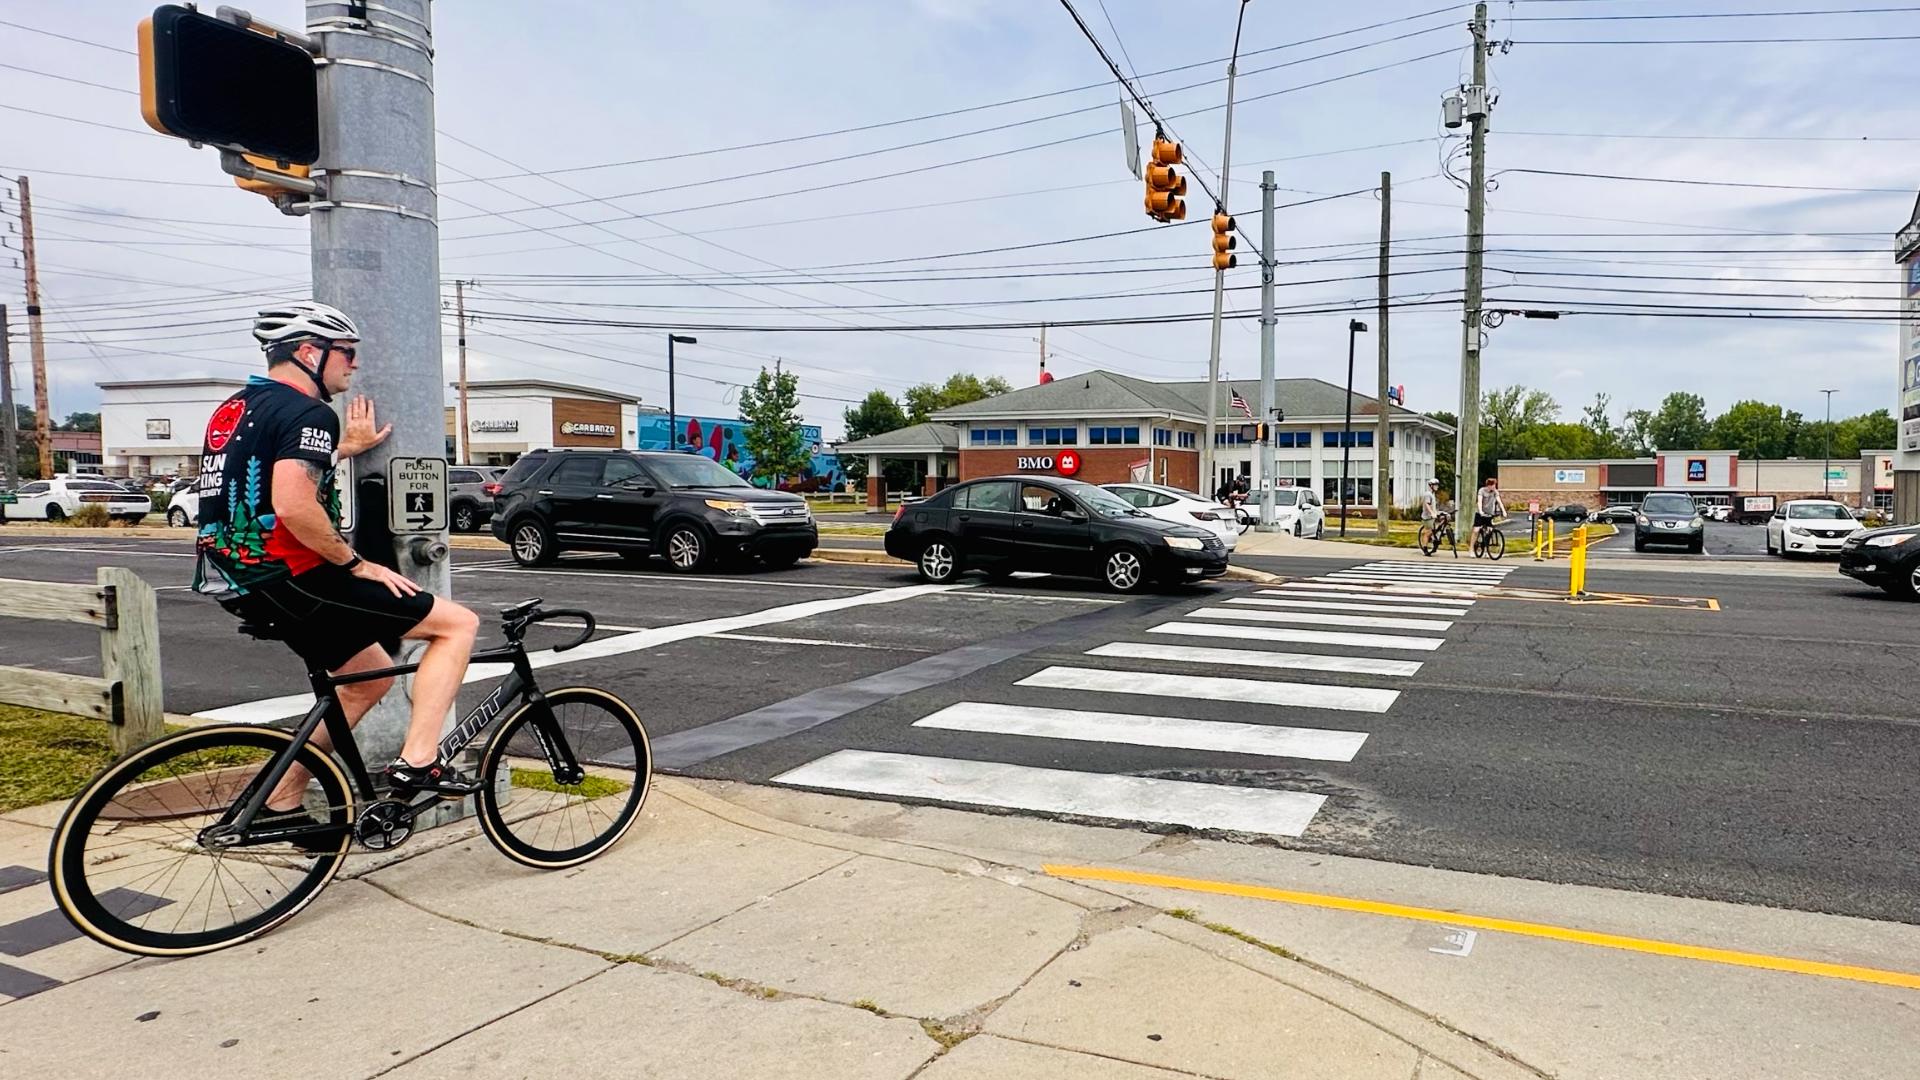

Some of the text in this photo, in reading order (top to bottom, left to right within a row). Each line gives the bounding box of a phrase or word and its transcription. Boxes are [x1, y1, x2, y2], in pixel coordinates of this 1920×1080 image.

[301, 427, 332, 441] SUN
[573, 423, 615, 433] GARBANZO
[300, 437, 332, 450] KING
[202, 453, 227, 473] SUN
[405, 462, 433, 471] PUSH
[1017, 456, 1053, 469] BMO
[399, 472, 439, 481] BUTTON
[409, 482, 429, 490] FOR
[440, 685, 502, 762] ANT
